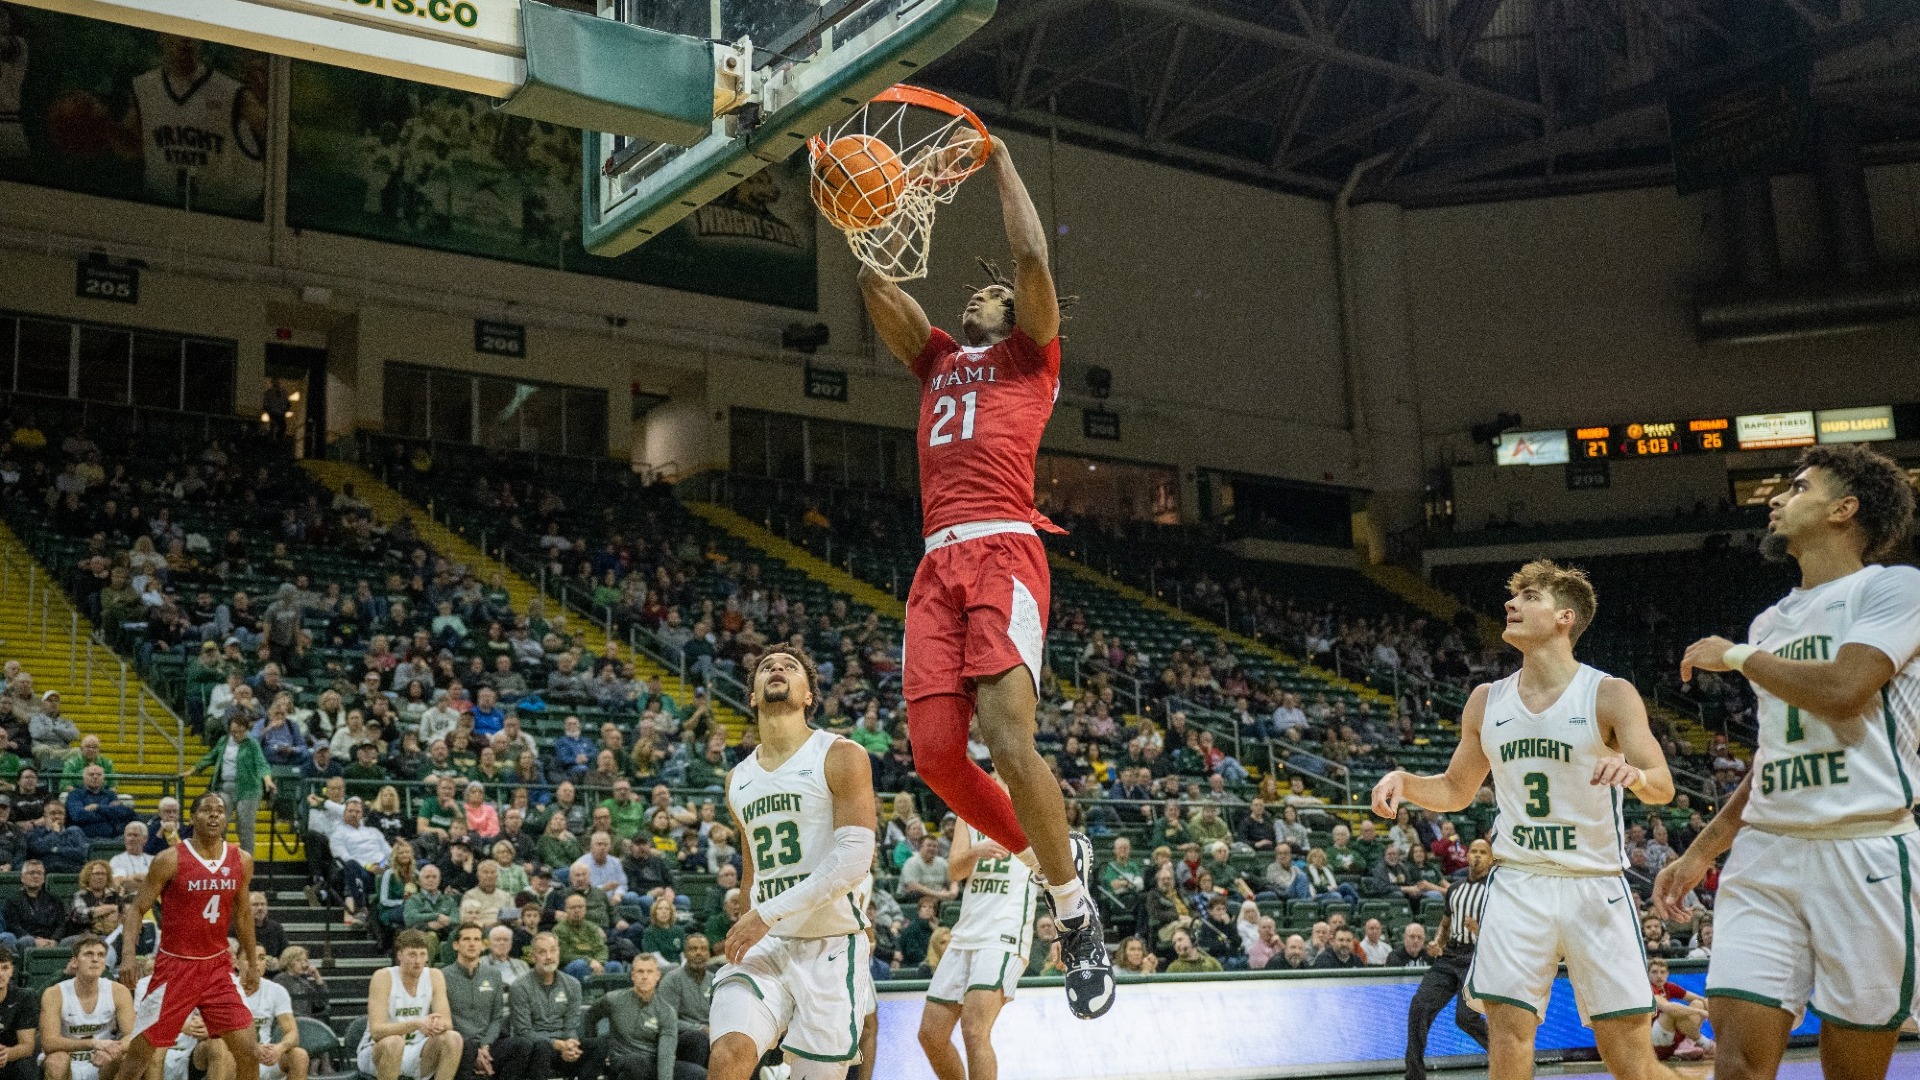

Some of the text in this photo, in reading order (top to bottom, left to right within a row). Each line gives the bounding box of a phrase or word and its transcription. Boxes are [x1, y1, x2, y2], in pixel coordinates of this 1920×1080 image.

[152, 124, 225, 155] WRIGHT
[86, 280, 130, 297] 205
[483, 336, 519, 352] 206
[811, 381, 841, 396] 207
[929, 390, 977, 448] 21
[1744, 419, 1807, 430] RAPID FIRED
[1820, 417, 1890, 433] BUD LIGHT
[1587, 440, 1608, 458] 27
[1636, 437, 1669, 455] 6:03
[1703, 433, 1722, 449] 26
[1773, 635, 1833, 660] IGHT
[1500, 738, 1573, 762] WRIGHT
[1761, 750, 1849, 796] STATE
[1523, 772, 1550, 818] 3
[742, 793, 802, 824] WRIGHT
[753, 820, 802, 872] 23
[1512, 825, 1577, 850] STATE
[187, 879, 237, 892] MIAMI
[970, 878, 1010, 895] STATE
[202, 894, 220, 924] 4
[70, 1052, 92, 1061] STA
